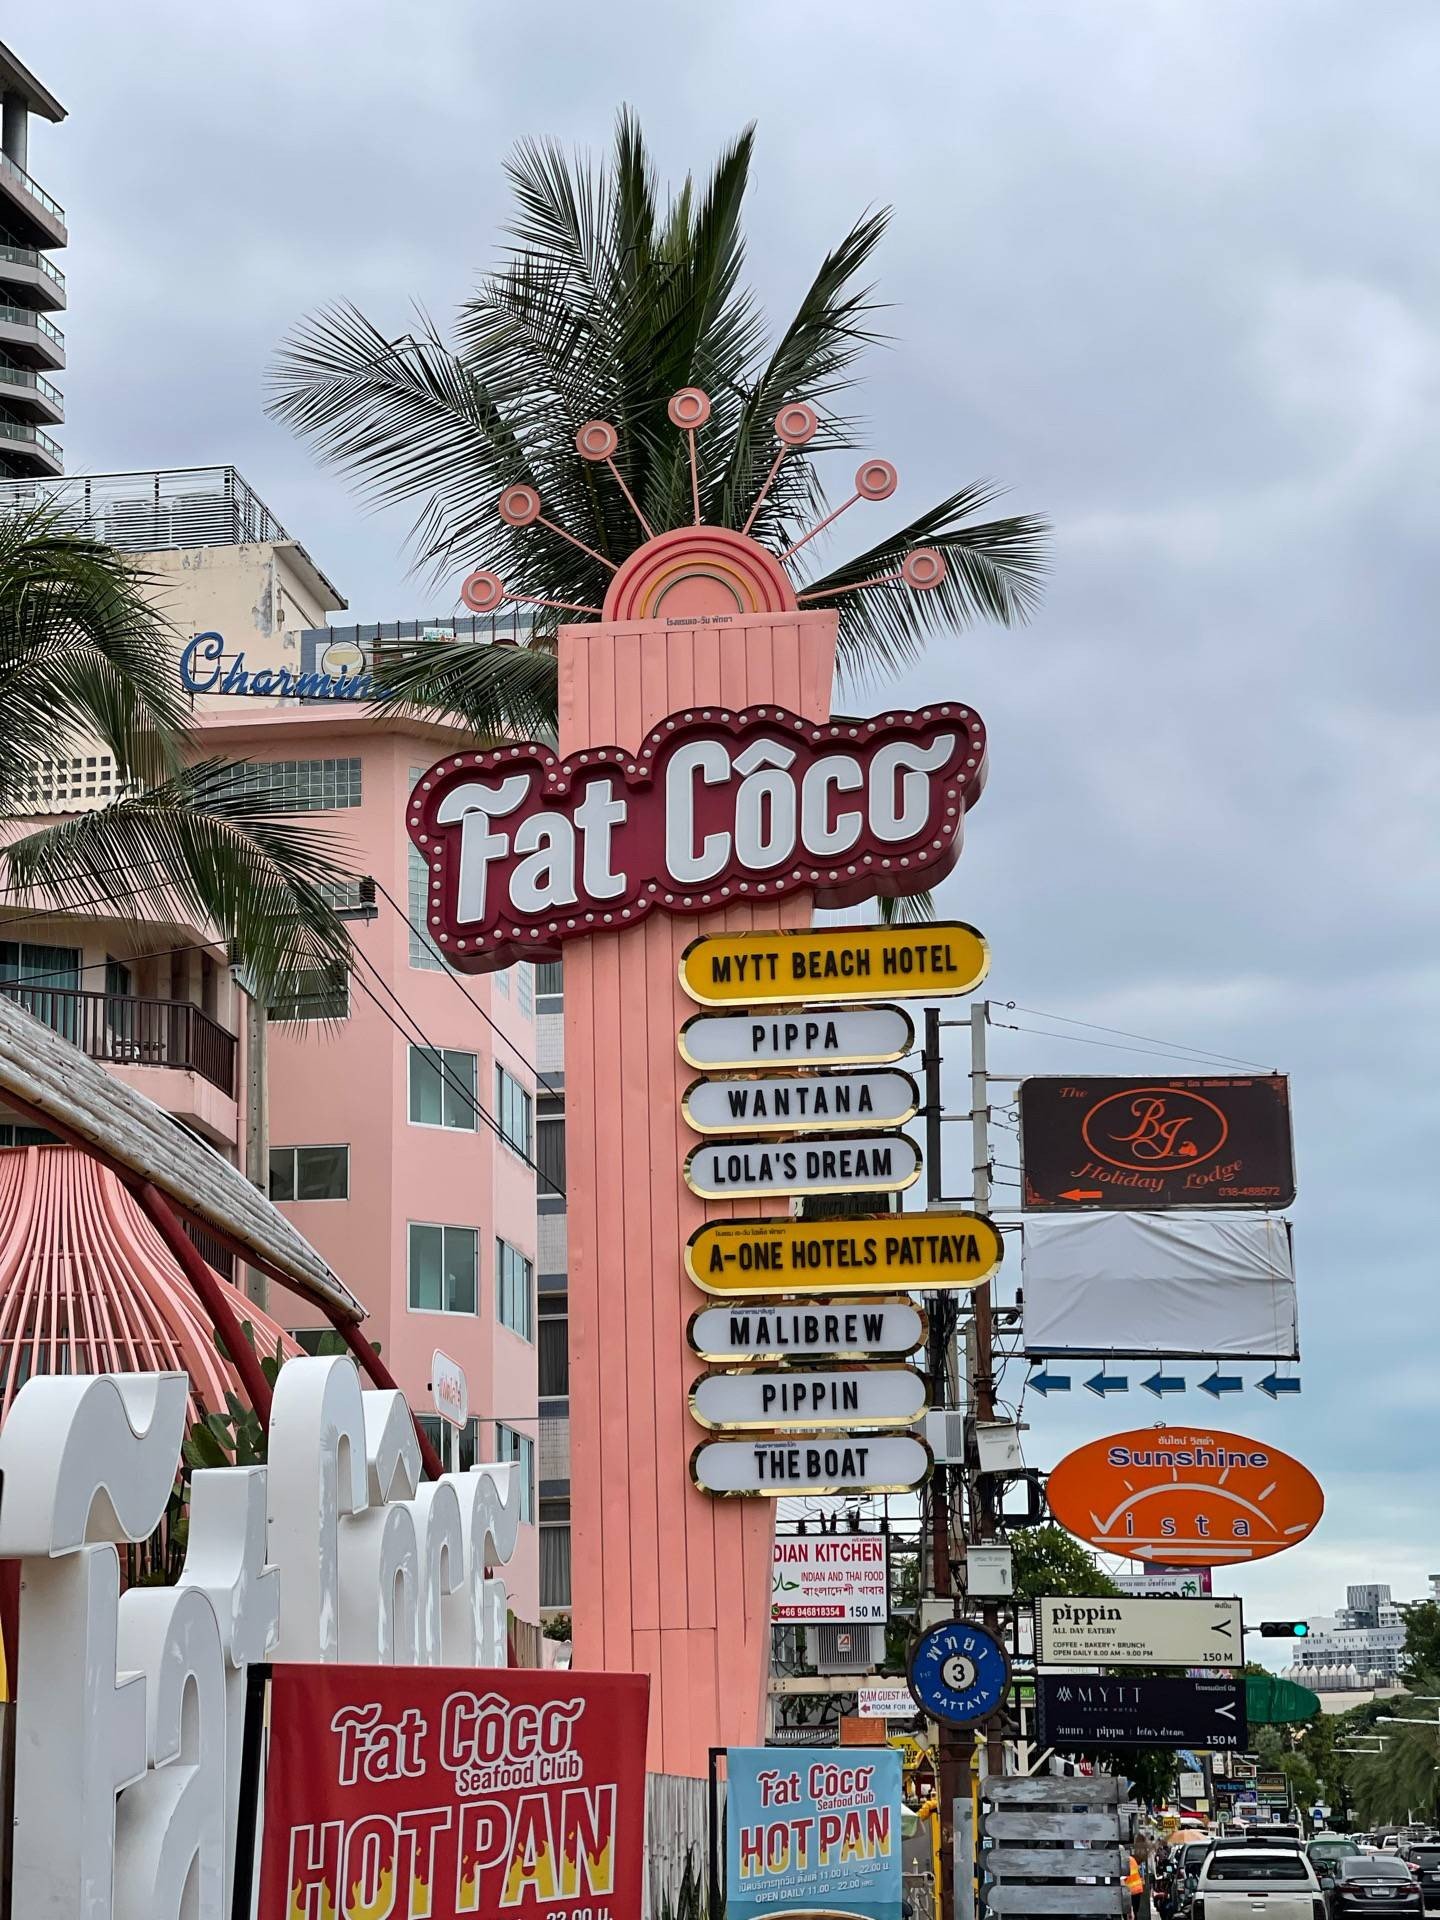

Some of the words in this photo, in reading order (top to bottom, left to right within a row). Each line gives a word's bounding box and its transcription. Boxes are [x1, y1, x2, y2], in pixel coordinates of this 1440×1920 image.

[712, 953, 780, 983] MYTT
[792, 949, 870, 979] BEACH
[883, 944, 957, 974] HOTEL
[752, 1021, 839, 1052] PIPPA
[727, 1084, 873, 1117] WANTANA
[1058, 1087, 1089, 1098] The
[713, 1152, 797, 1184] LOLA'S
[806, 1148, 892, 1179] DREAM
[1071, 1162, 1165, 1192] Holiday
[1183, 1159, 1243, 1190] Lodge
[709, 1242, 783, 1273] A-ONE
[791, 1238, 877, 1269] HOTELS
[886, 1234, 981, 1265] PATTAYA
[730, 1313, 884, 1345] MALIBREW
[762, 1381, 858, 1412] PIPPIN
[754, 1450, 800, 1480] THE
[807, 1448, 869, 1479] BOAT
[1107, 1446, 1269, 1468] Sunshine
[815, 1543, 883, 1562] KITCHEN
[801, 1571, 825, 1581] INDIAN
[828, 1571, 843, 1581] AND
[845, 1571, 862, 1581] THAI
[864, 1570, 884, 1580] FOOD
[781, 1607, 796, 1617] +66
[797, 1607, 840, 1616] 946818354
[849, 1605, 868, 1617] 150
[871, 1605, 885, 1617] M.
[1087, 1627, 1117, 1635] EATERY
[1202, 1652, 1222, 1662] 150
[1223, 1653, 1233, 1662] M
[952, 1663, 965, 1682] 3
[860, 1690, 877, 1701] SIAM
[878, 1690, 899, 1701] GUEST
[932, 1690, 989, 1711] PATTAYA
[1078, 1687, 1142, 1703] MYTT
[1096, 1726, 1124, 1738] pippa
[1160, 1727, 1184, 1737] dream
[1206, 1736, 1226, 1745] 150
[1227, 1736, 1237, 1745] M
[458, 1764, 535, 1795] Seafood
[540, 1754, 580, 1783] Club
[817, 1797, 853, 1811] Seafood
[855, 1791, 874, 1805] Club
[286, 1806, 452, 1920] HOT
[456, 1784, 618, 1914] PAN
[739, 1817, 815, 1879] HOT
[818, 1805, 891, 1867] PAN
[819, 1869, 841, 1880] 11.00
[859, 1863, 881, 1875] 22.00
[755, 1891, 779, 1903] OPEN
[780, 1888, 805, 1900] DAILY
[807, 1884, 830, 1895] 11.00
[838, 1879, 860, 1891] 22.00
